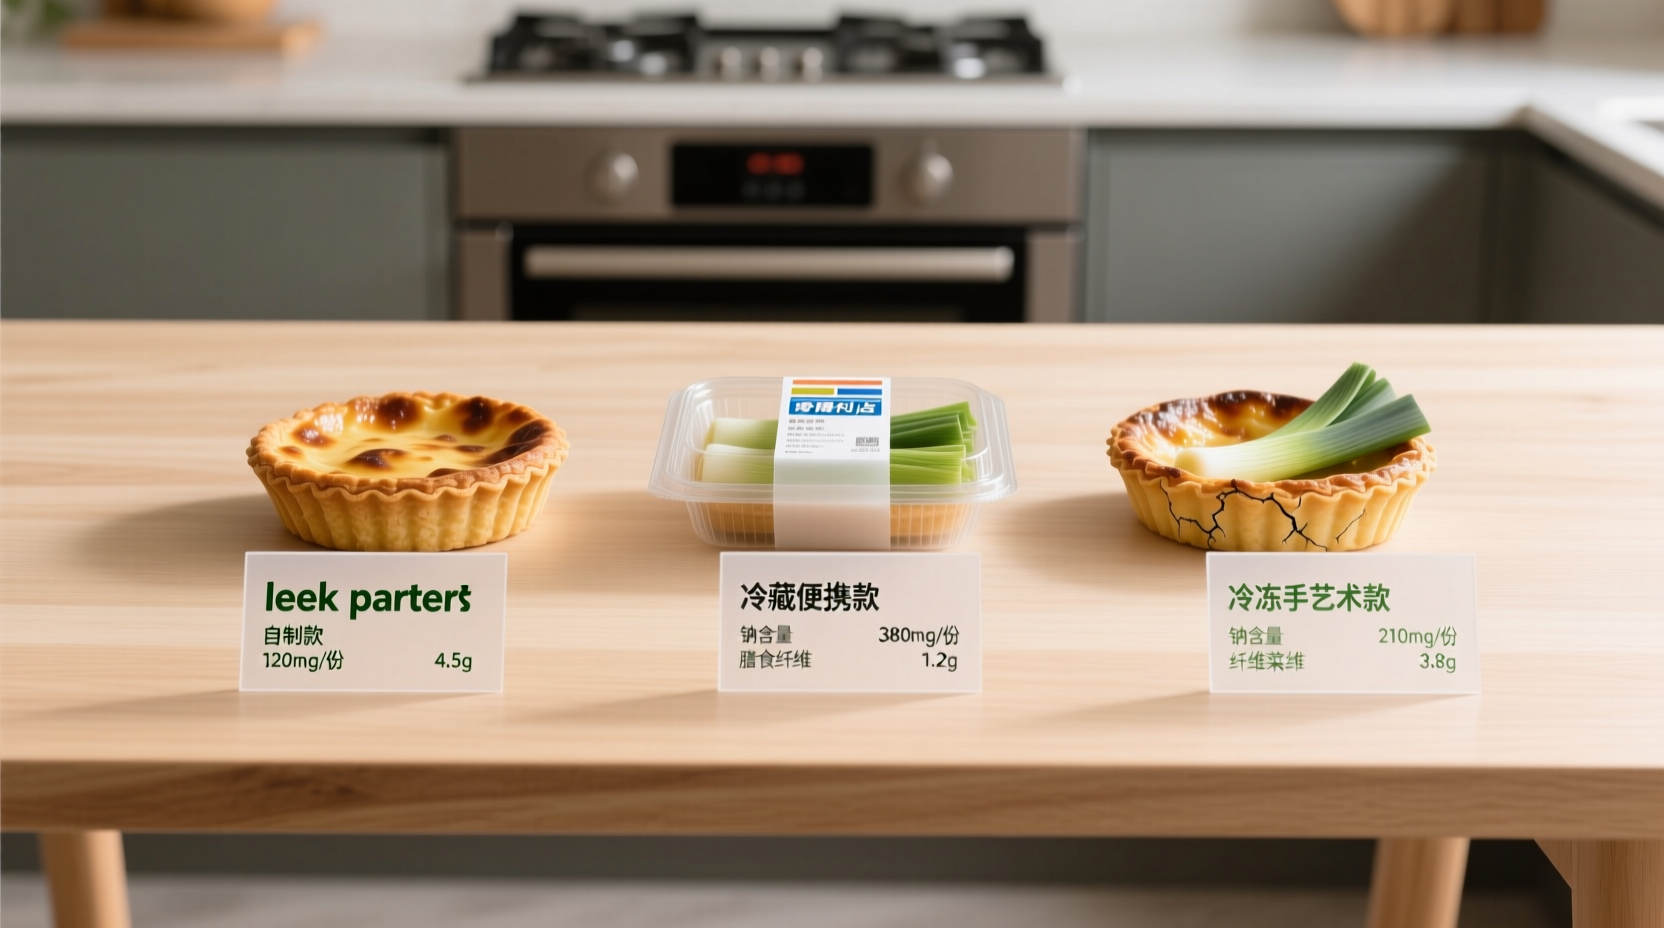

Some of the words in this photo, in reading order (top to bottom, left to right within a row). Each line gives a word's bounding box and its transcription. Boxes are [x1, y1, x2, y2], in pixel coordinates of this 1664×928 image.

[265, 581, 339, 612] leek
[740, 581, 880, 612] 冷藏便携款
[1227, 582, 1391, 612] 冷冻手艺术款
[264, 624, 324, 646] 自制款
[740, 624, 793, 645] 钠含量
[878, 624, 960, 647] 380mg/份
[1228, 625, 1284, 645] 钠含量
[1378, 625, 1457, 648] 210mg/份
[263, 650, 344, 672] 120mg/份
[434, 652, 472, 673] 4.5g
[921, 652, 958, 672] 1.2g
[1419, 653, 1457, 674] 3.8g
